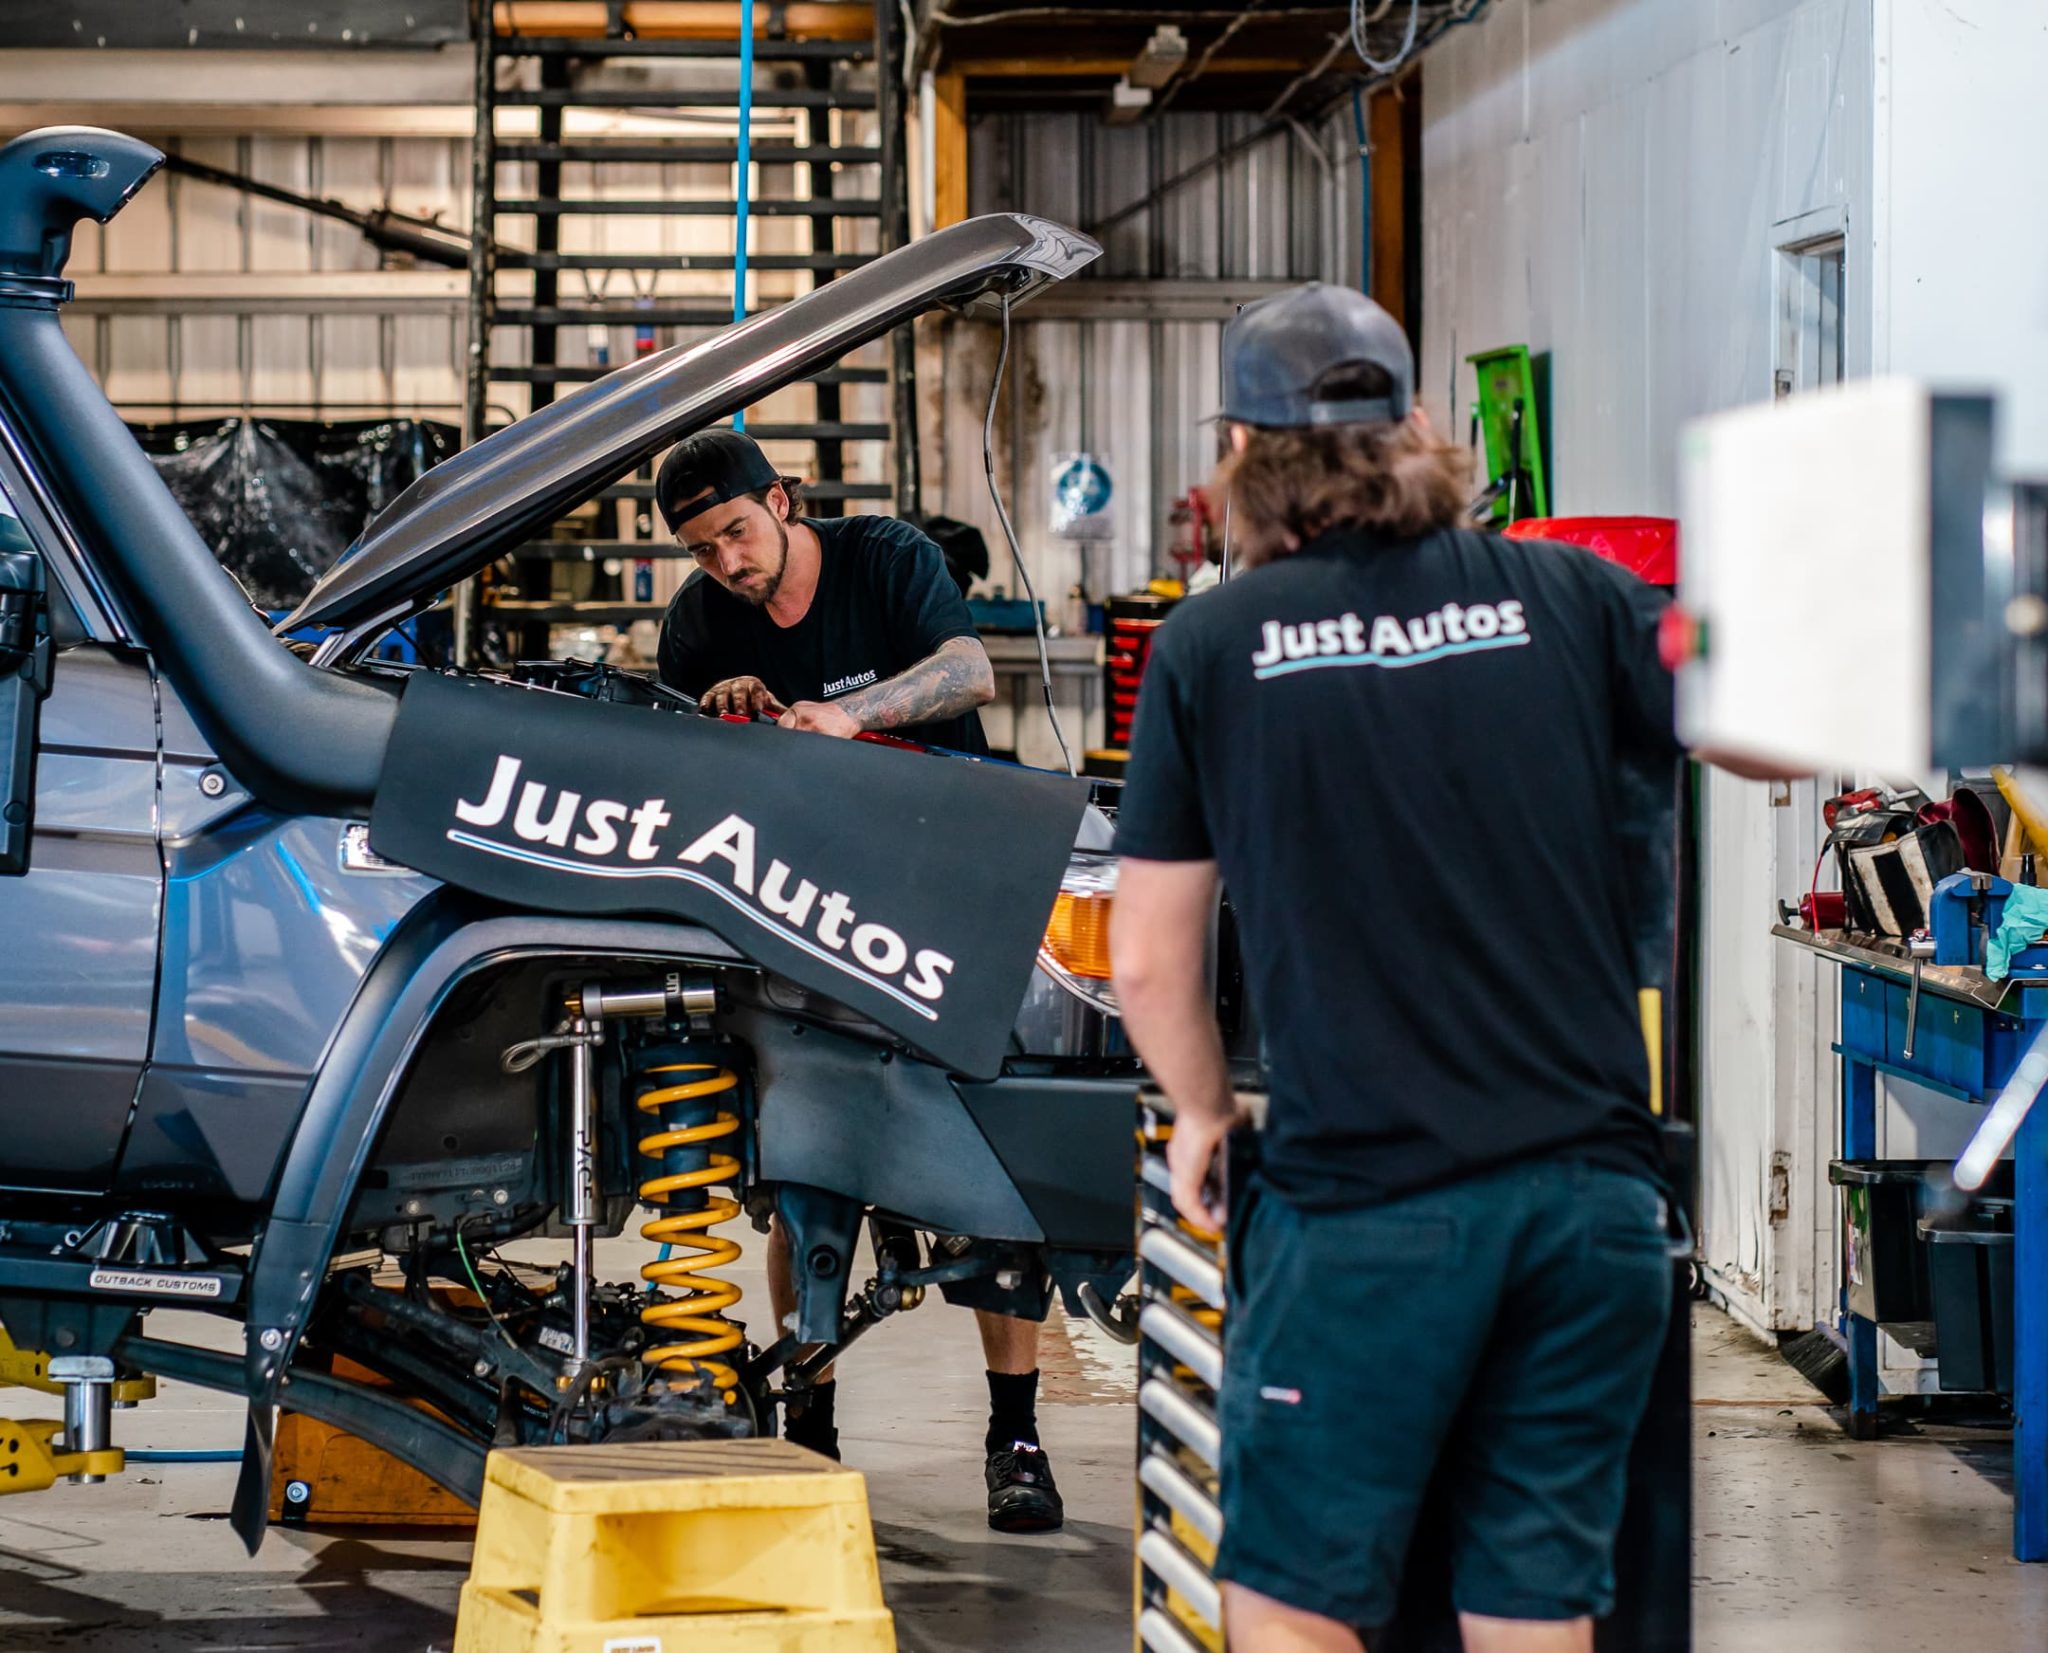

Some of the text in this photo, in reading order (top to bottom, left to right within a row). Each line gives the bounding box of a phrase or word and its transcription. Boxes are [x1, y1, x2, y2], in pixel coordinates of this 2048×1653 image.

[1252, 600, 1526, 666] Just Autos
[455, 755, 955, 1001] Just Autos
[94, 1275, 216, 1292] OUTBACK CUSTOMS
